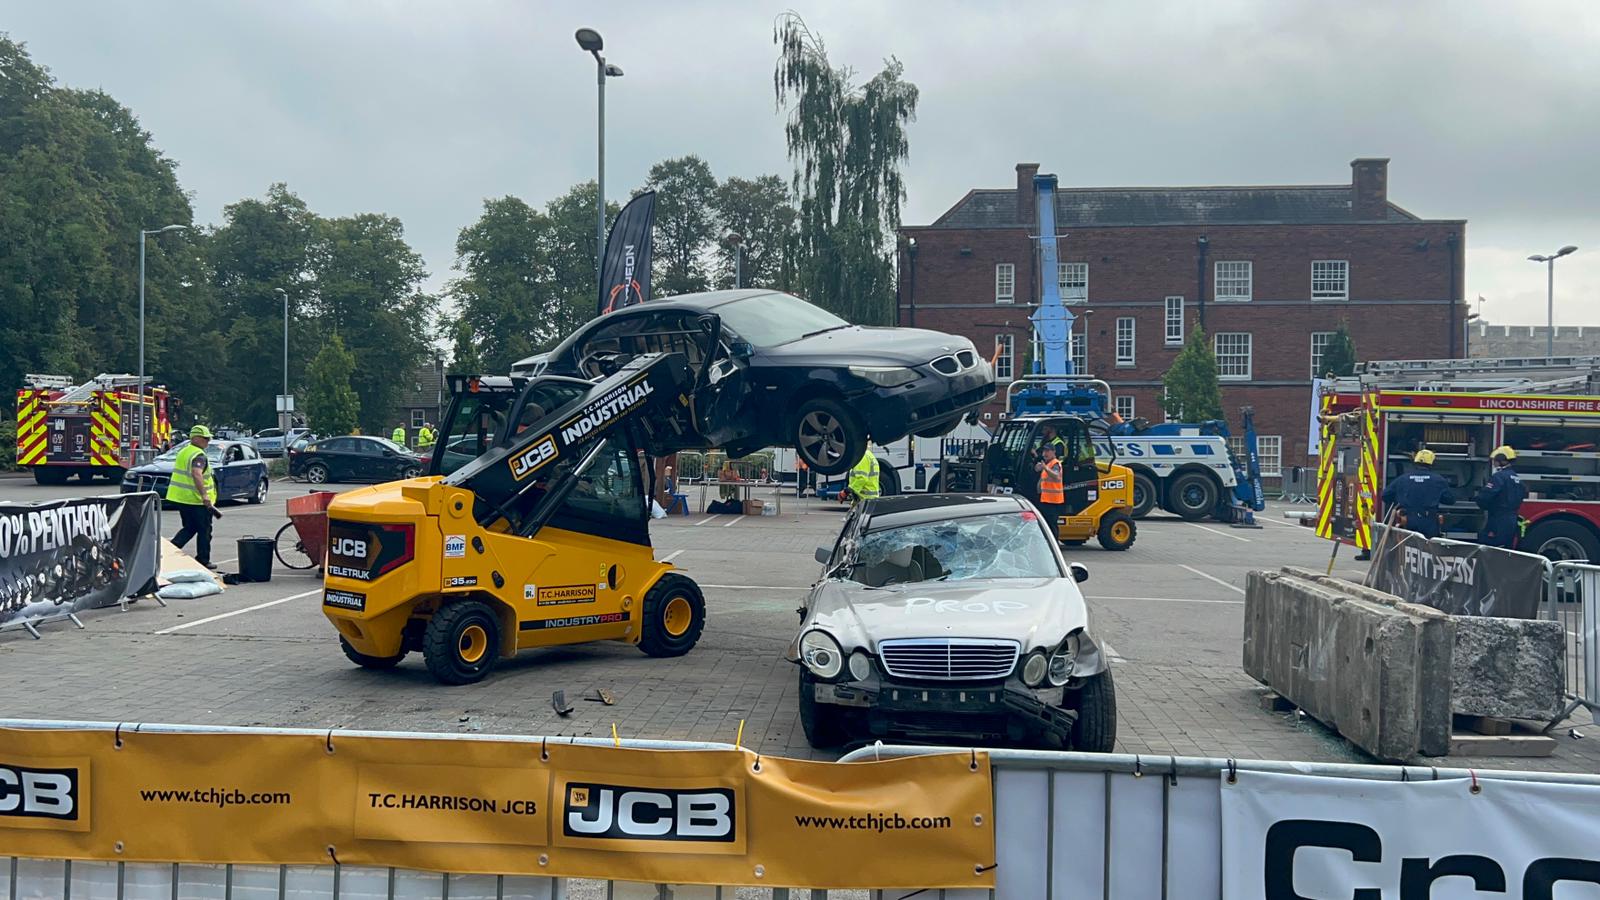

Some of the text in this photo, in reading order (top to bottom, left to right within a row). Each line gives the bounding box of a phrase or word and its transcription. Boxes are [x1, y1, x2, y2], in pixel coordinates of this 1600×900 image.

[561, 380, 654, 446] INDUSTRIAL
[1480, 399, 1564, 410] LINCOLNSHIRE
[1567, 401, 1594, 411] FIRE
[516, 440, 555, 475] JCB
[1101, 480, 1124, 489] JCB
[28, 503, 112, 554] PENTHEON
[332, 538, 367, 558] JCB
[446, 543, 465, 551] BMF
[328, 565, 370, 580] TELETRUK
[326, 593, 363, 607] INDUSTRIAL
[541, 588, 594, 599] T.C.HARRISON
[140, 787, 291, 808] www.tchjcb.com
[368, 793, 537, 815] T.C.HARRISON JCB
[568, 789, 731, 837] JCB
[795, 813, 951, 833] www.tchjcb.com
